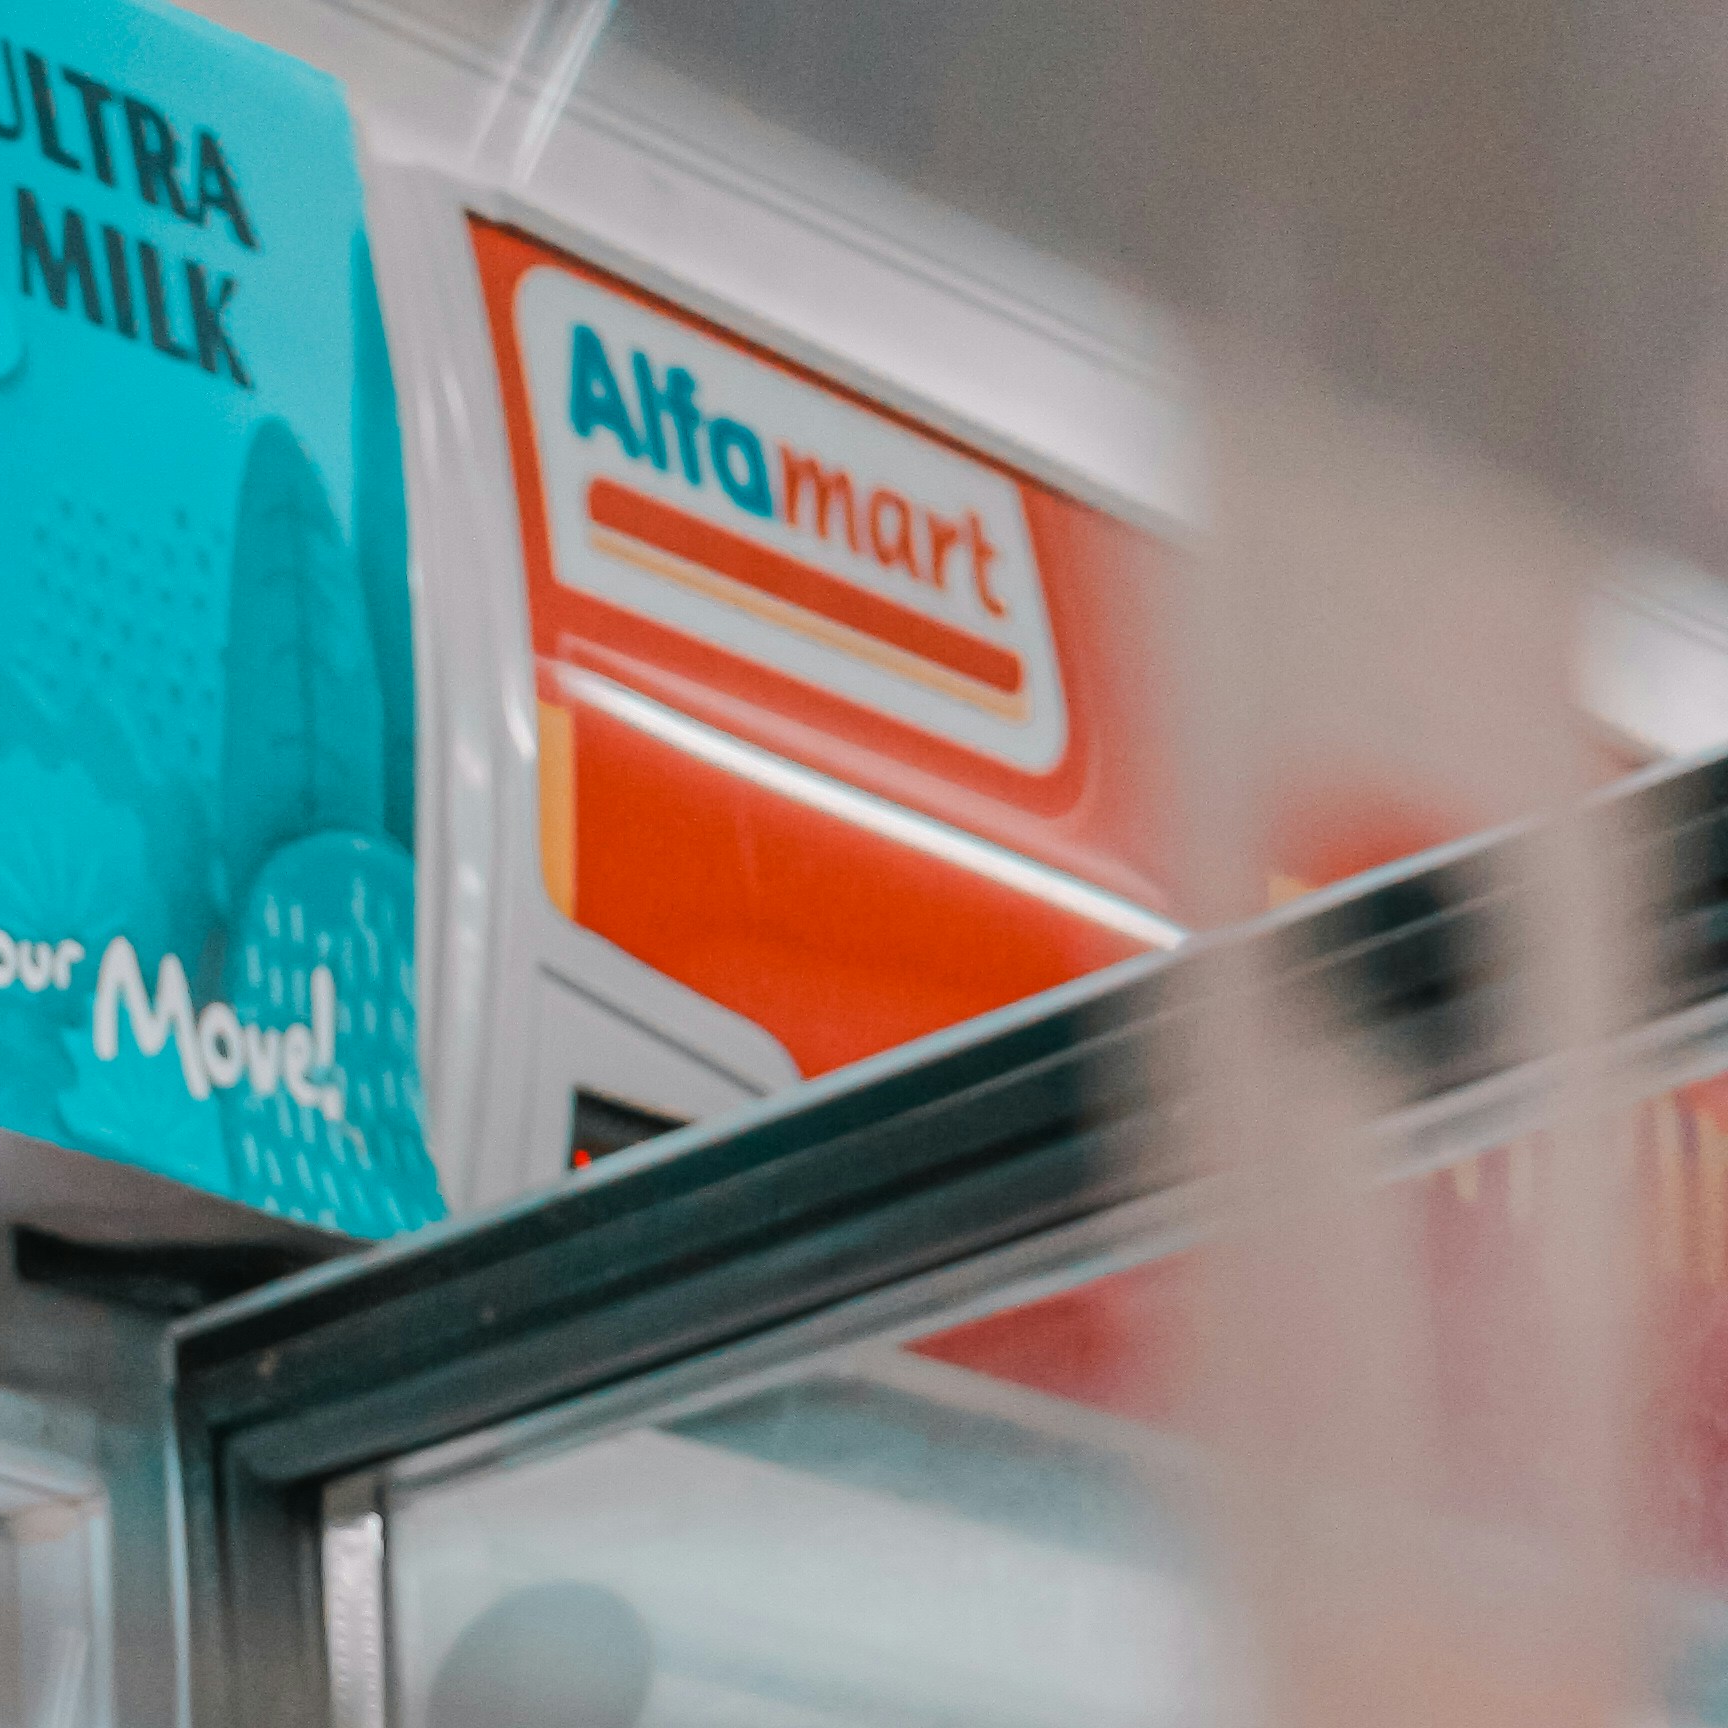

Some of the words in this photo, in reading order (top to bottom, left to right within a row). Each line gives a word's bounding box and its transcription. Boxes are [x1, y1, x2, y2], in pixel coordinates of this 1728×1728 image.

[16, 188, 255, 390] MILK
[566, 323, 1008, 618] Alfamart
[92, 935, 345, 1120] Move!
